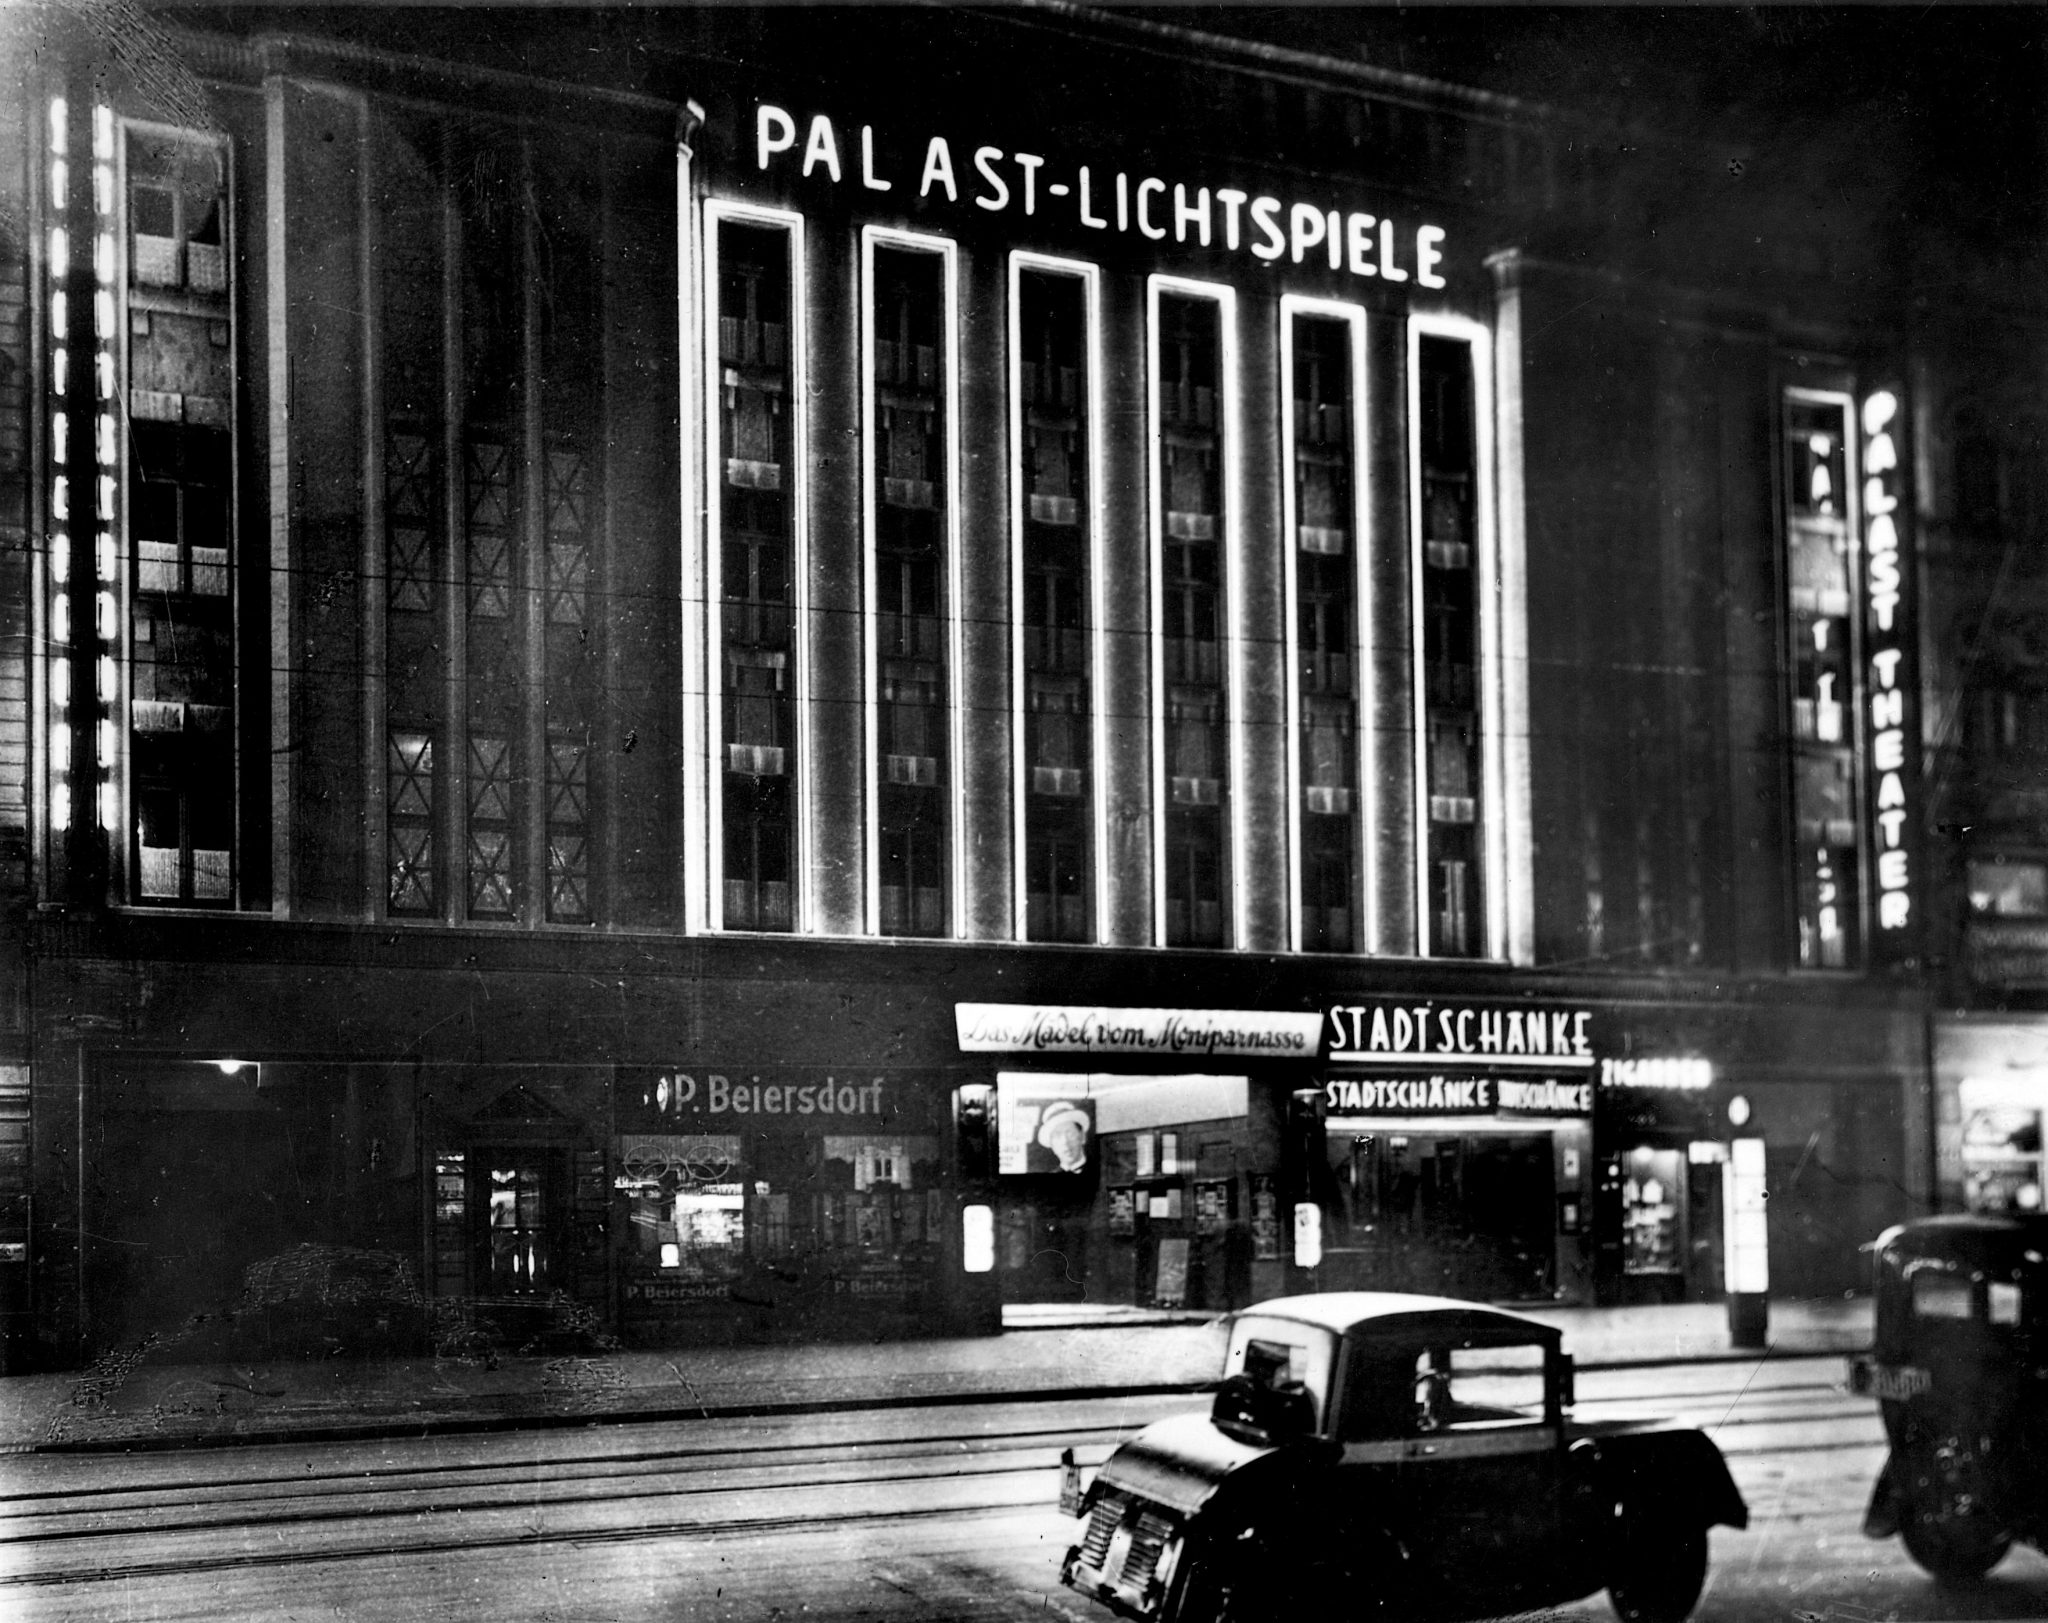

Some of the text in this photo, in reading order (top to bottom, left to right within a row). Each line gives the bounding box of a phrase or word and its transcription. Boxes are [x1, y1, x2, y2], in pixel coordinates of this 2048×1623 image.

[1871, 648, 1910, 930] THEATER
[1097, 1023, 1145, 1047] vom
[674, 1073, 885, 1114] P. Beiersdorf
[1327, 1074, 1590, 1110] STADTSCHÄNKE SCHÄNKE
